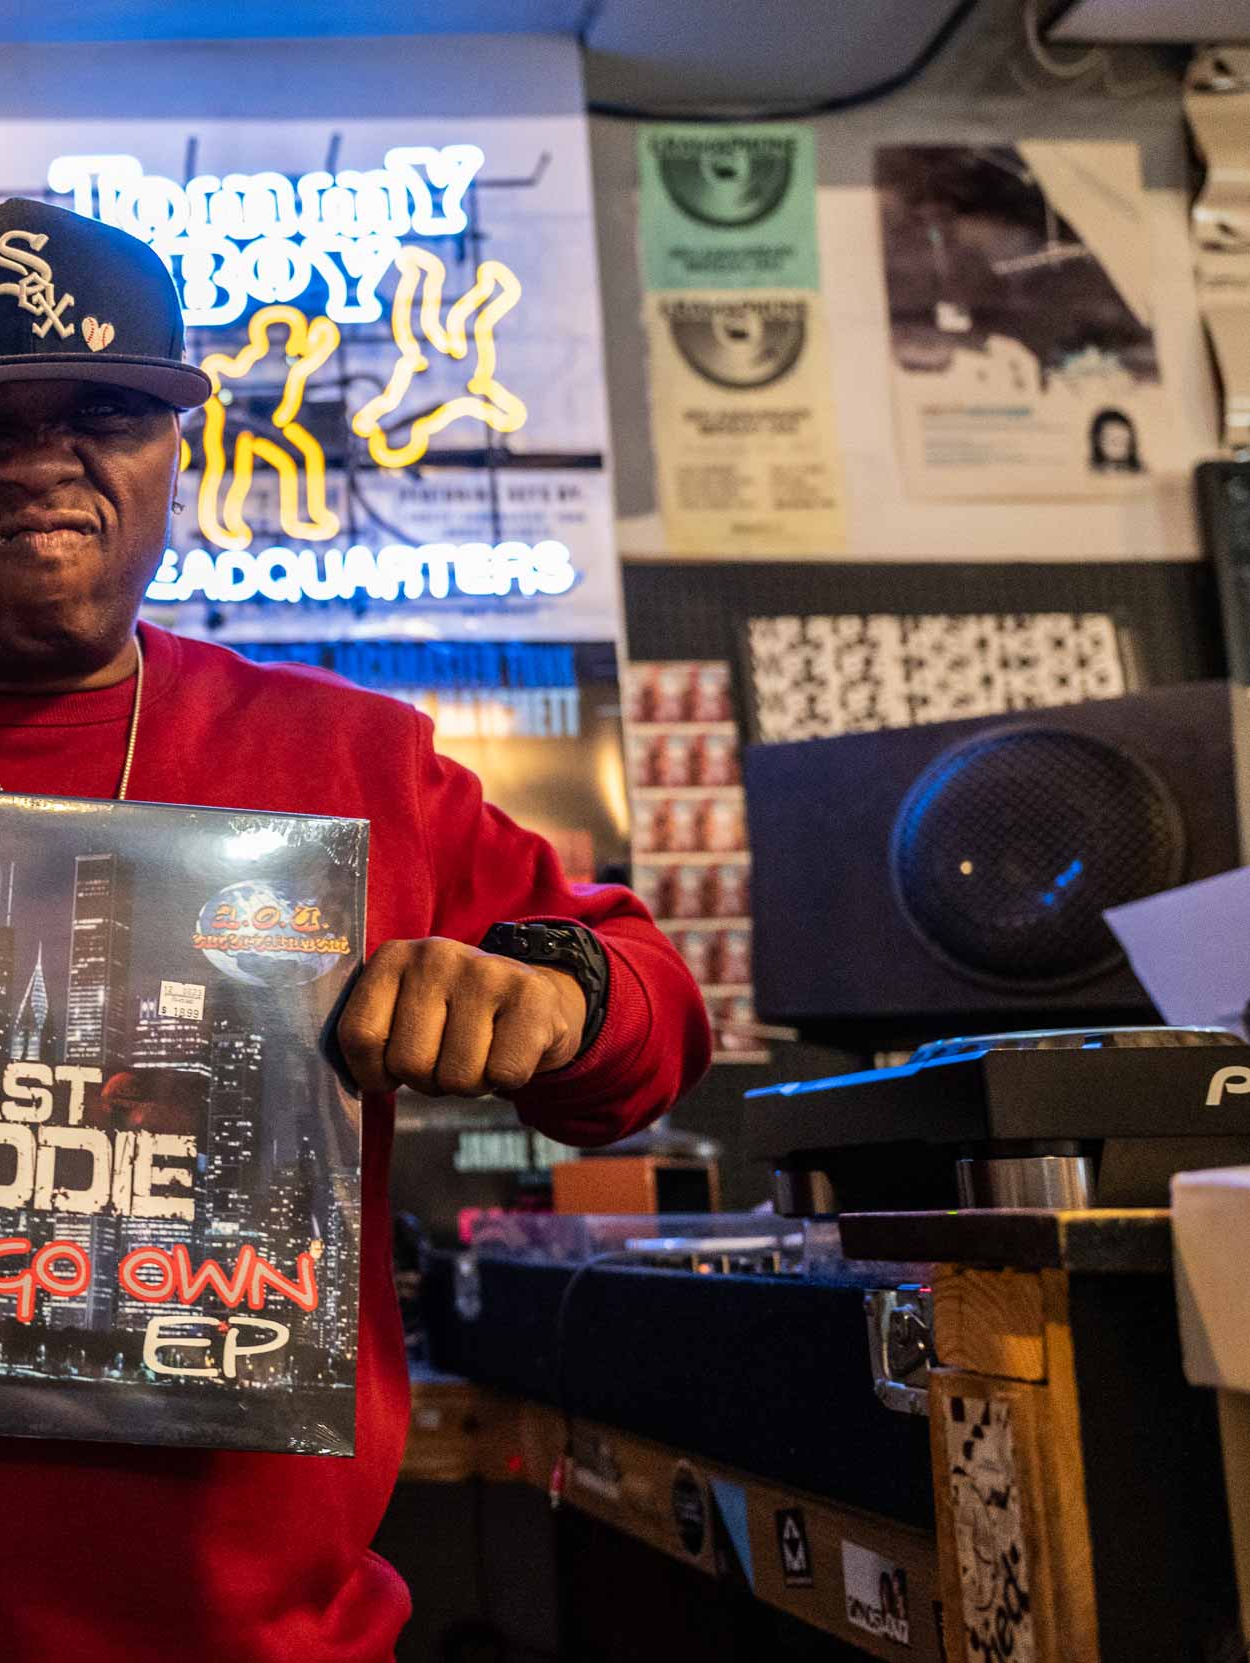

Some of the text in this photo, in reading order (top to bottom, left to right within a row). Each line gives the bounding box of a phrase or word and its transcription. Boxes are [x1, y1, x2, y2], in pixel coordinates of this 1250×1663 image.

[144, 541, 575, 603] EADQUARTERS
[118, 1240, 321, 1312] OWN
[141, 1315, 292, 1380] EP
